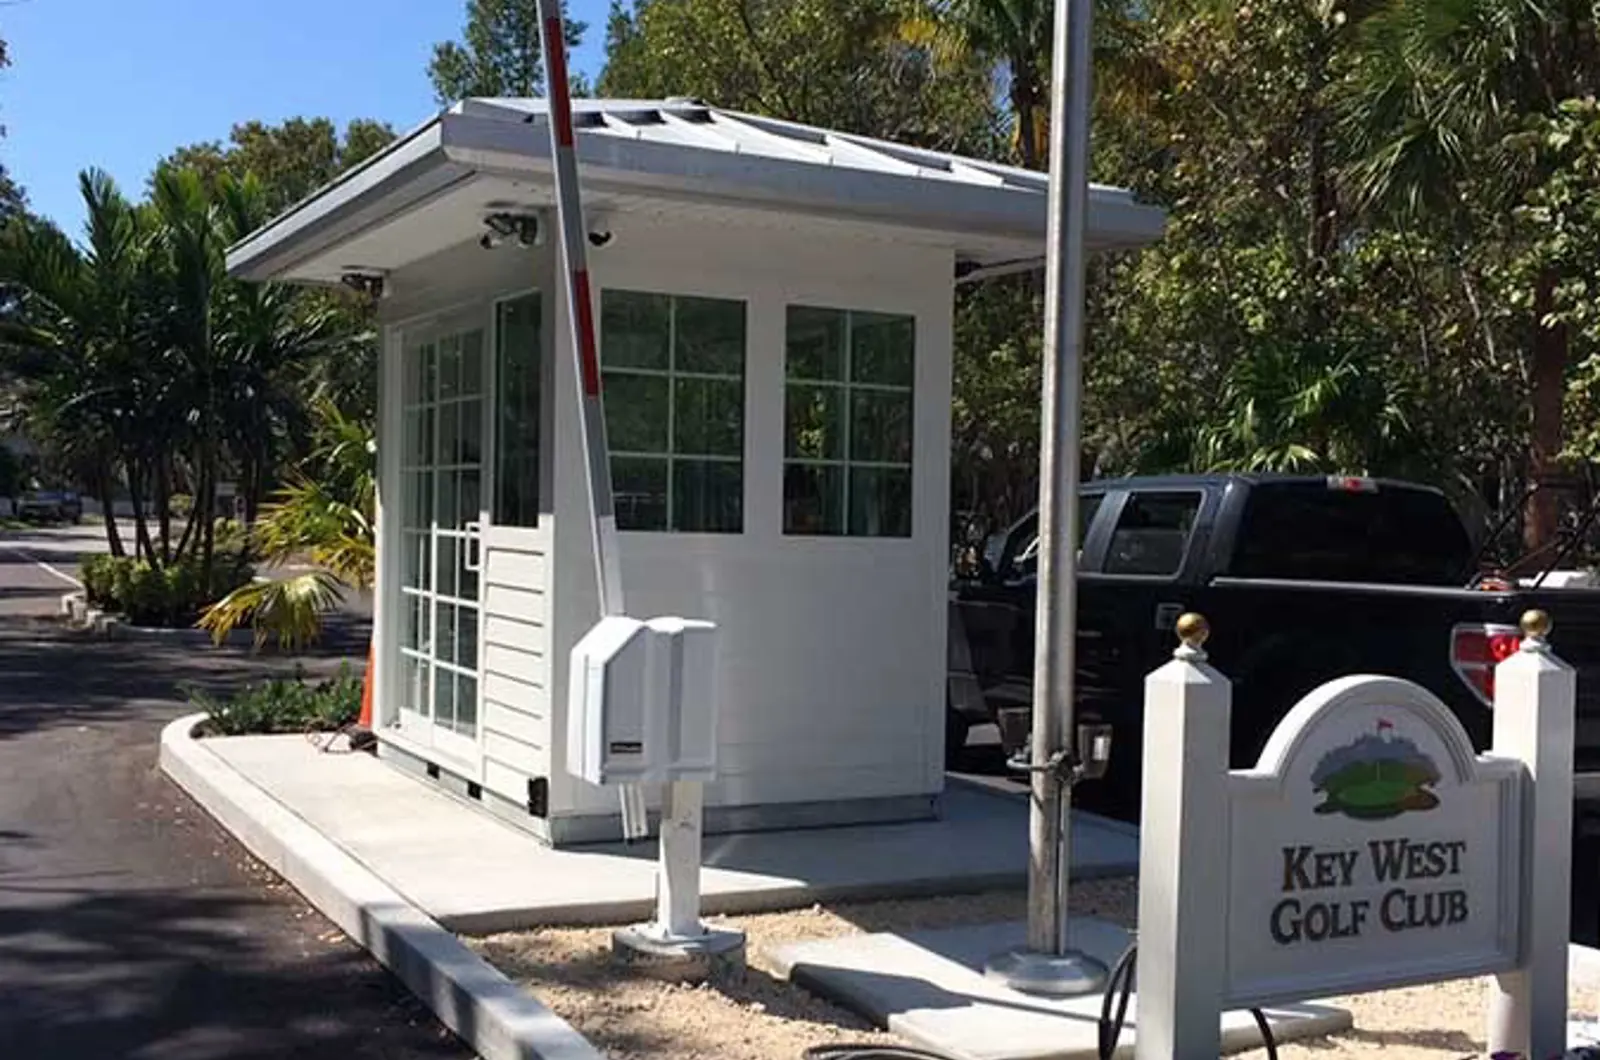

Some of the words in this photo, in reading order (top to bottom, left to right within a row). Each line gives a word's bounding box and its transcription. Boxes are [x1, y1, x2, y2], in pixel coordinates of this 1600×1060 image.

[1282, 846, 1358, 892] KEY
[1368, 838, 1466, 882] WEST
[1270, 898, 1369, 944] GOLF
[1380, 888, 1468, 932] CLUB
